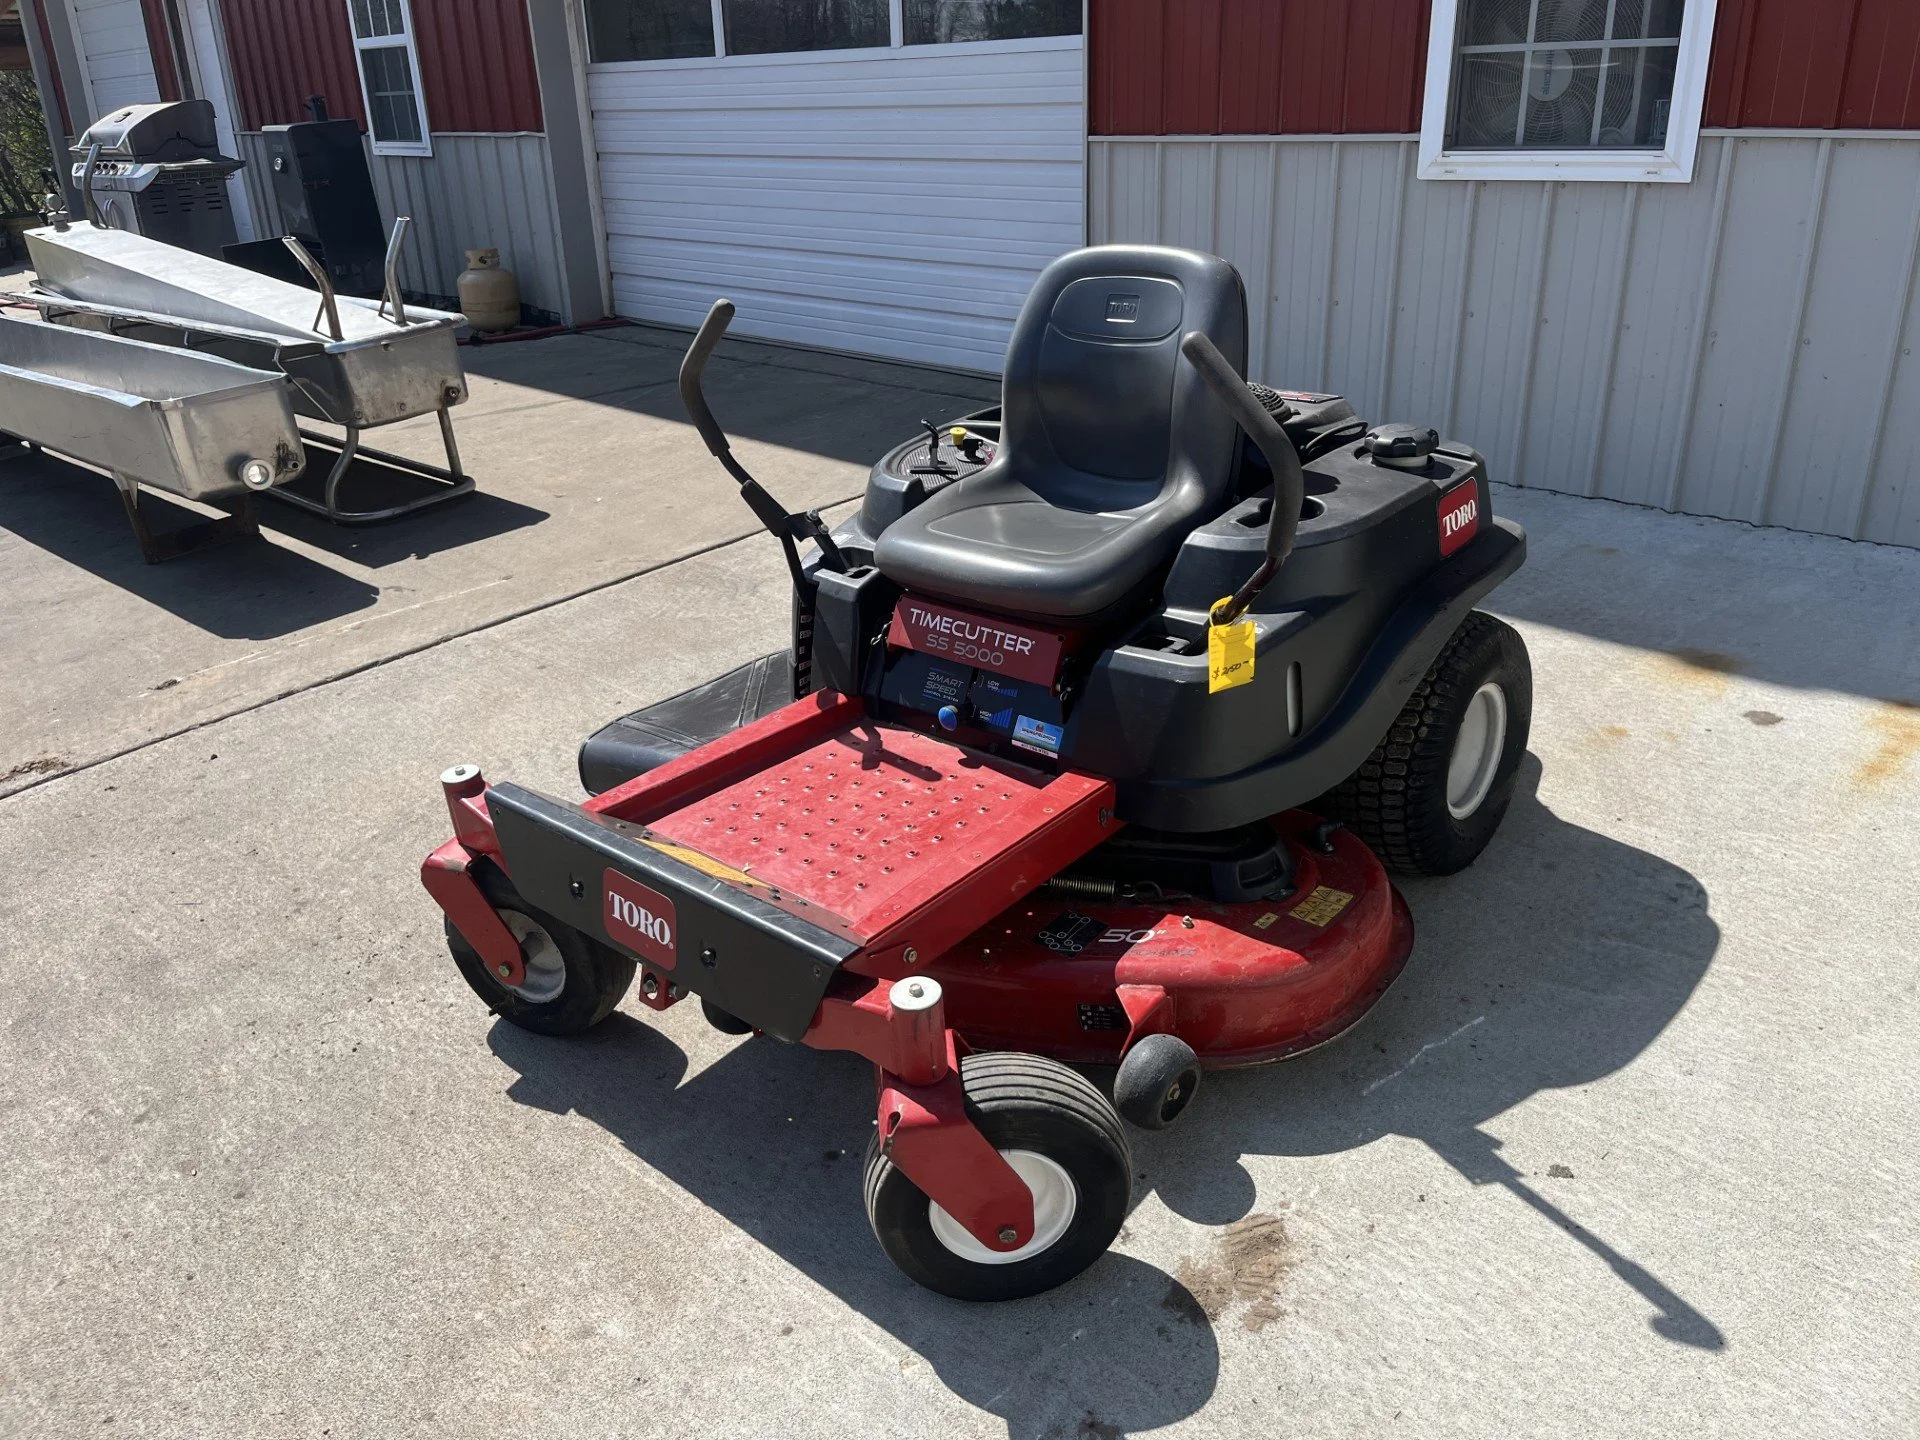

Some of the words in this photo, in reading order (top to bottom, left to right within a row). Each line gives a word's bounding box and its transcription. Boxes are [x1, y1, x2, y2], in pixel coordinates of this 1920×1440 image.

[1442, 499, 1476, 537] TORO
[910, 607, 1032, 655] TIMECUTTER
[926, 633, 949, 651] SS
[953, 641, 1004, 666] 5000
[925, 680, 957, 696] SPEED
[927, 671, 964, 688] SMART
[608, 890, 671, 946] TORO
